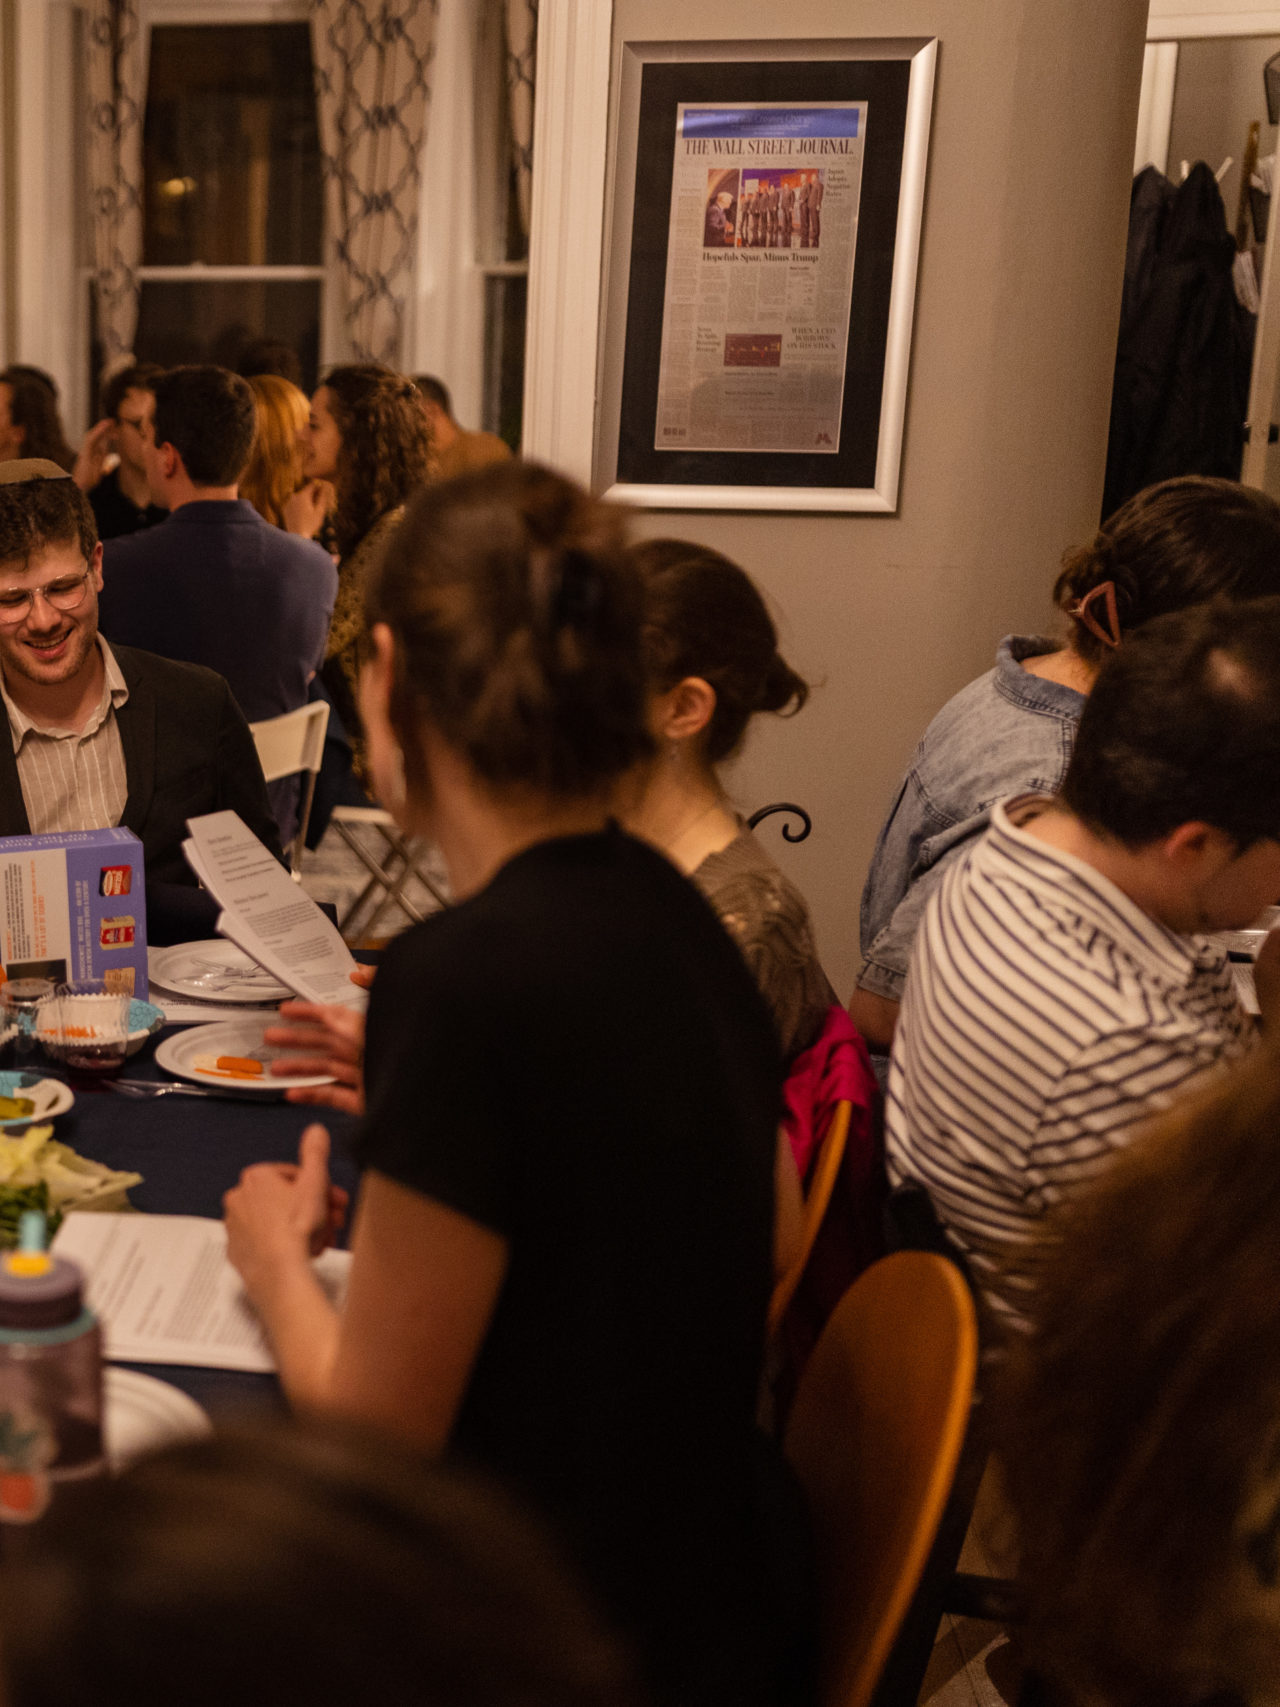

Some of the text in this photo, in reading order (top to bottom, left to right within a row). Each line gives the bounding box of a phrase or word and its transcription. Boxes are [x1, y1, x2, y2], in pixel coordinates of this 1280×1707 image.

[685, 139, 710, 155] THE
[713, 139, 745, 155] WALL
[748, 139, 794, 155] STREET
[702, 252, 739, 263] Hopefuls
[764, 252, 790, 261] Minus
[791, 252, 819, 263] Trump
